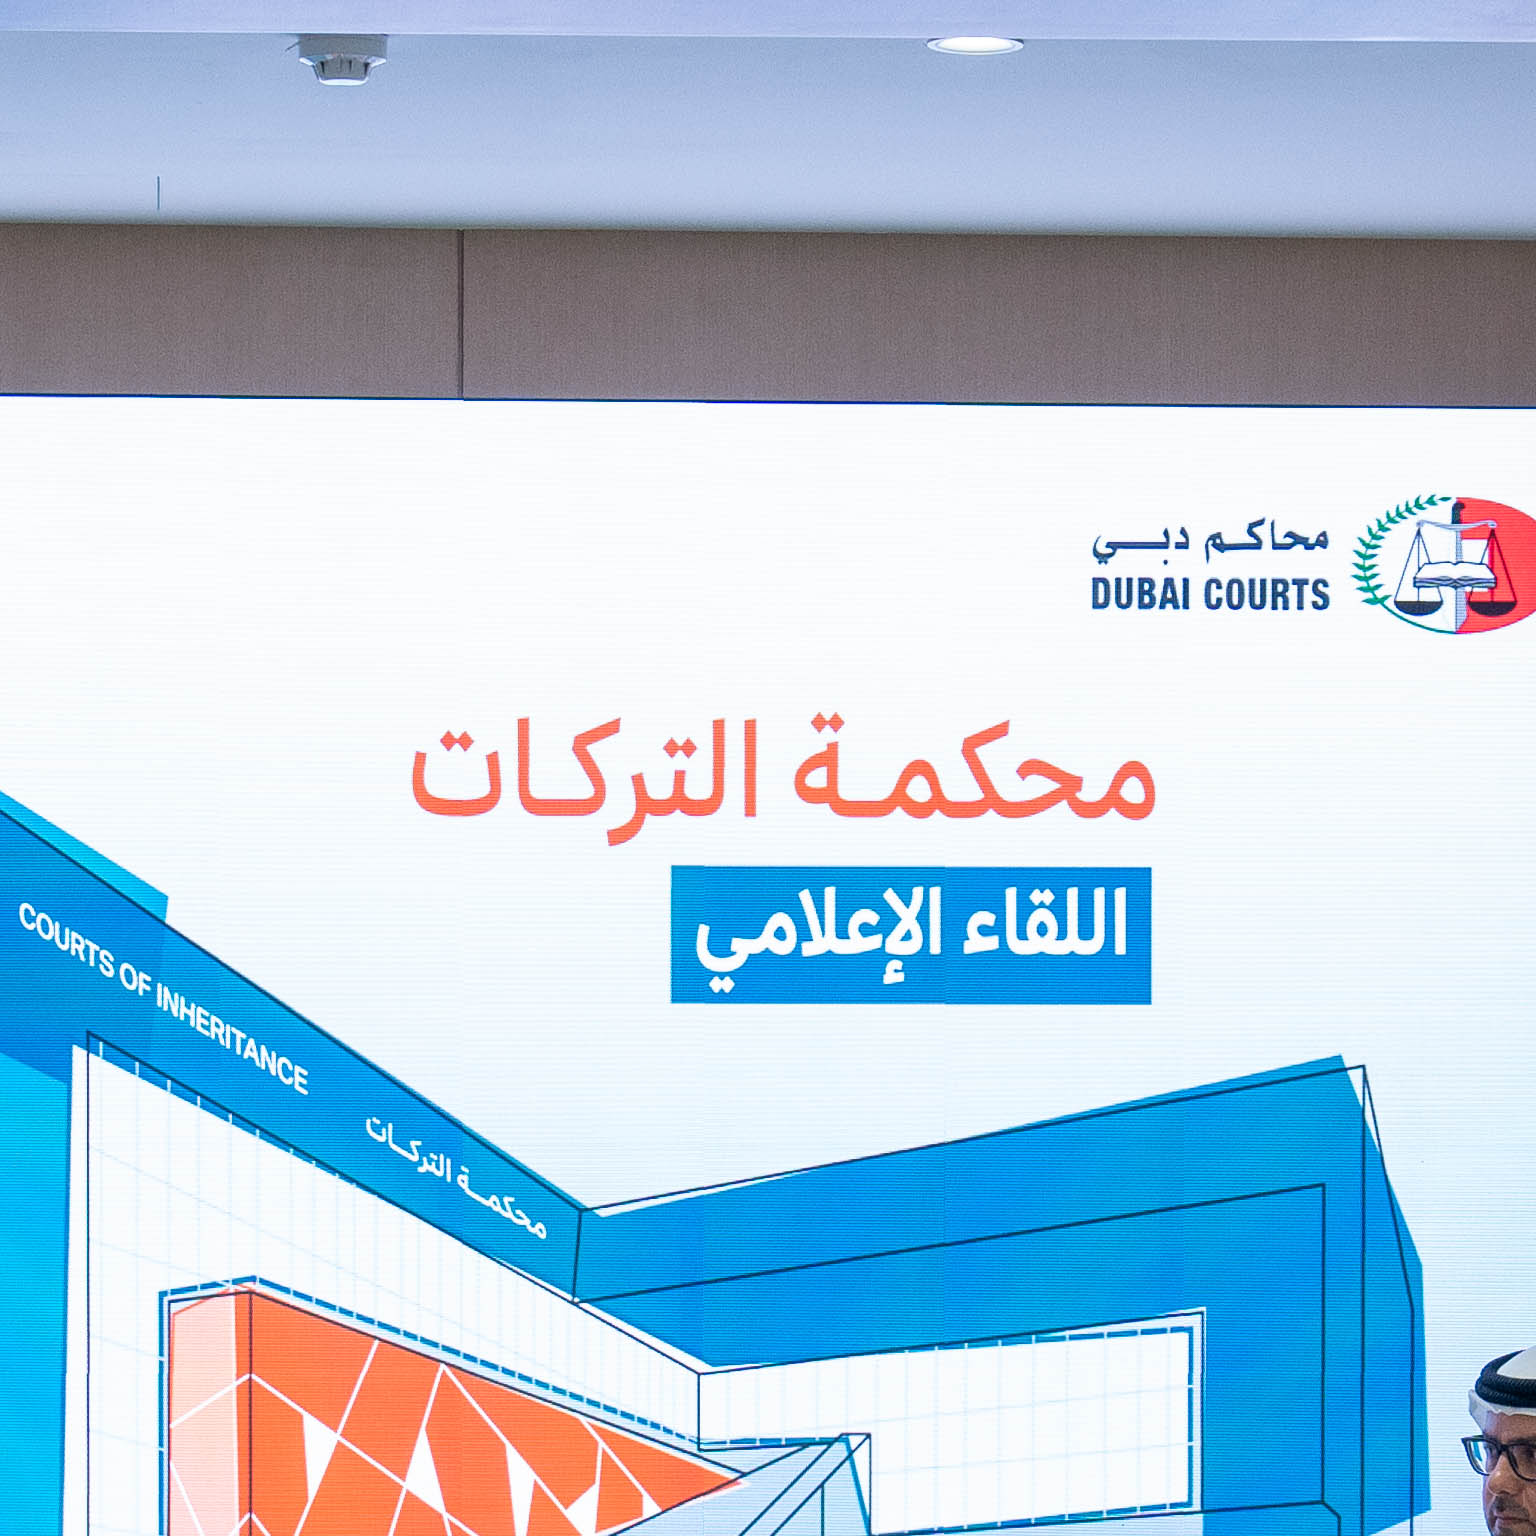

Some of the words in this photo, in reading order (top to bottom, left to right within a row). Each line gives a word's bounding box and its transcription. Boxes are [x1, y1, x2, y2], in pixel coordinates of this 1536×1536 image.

[1091, 525, 1190, 566] دبي
[1204, 517, 1330, 565] محاكم
[1091, 576, 1190, 611] DUBAI
[1203, 577, 1331, 612] COURTS
[412, 717, 757, 847] التركات
[794, 711, 1156, 822] محكمة
[696, 886, 942, 993] الإعلامي
[963, 886, 1127, 957] اللقاء
[18, 902, 115, 978] COURTS
[119, 962, 152, 996] OF
[156, 982, 309, 1095] INHERITANCE
[365, 1117, 452, 1183] التركات
[456, 1165, 547, 1240] محكمة
